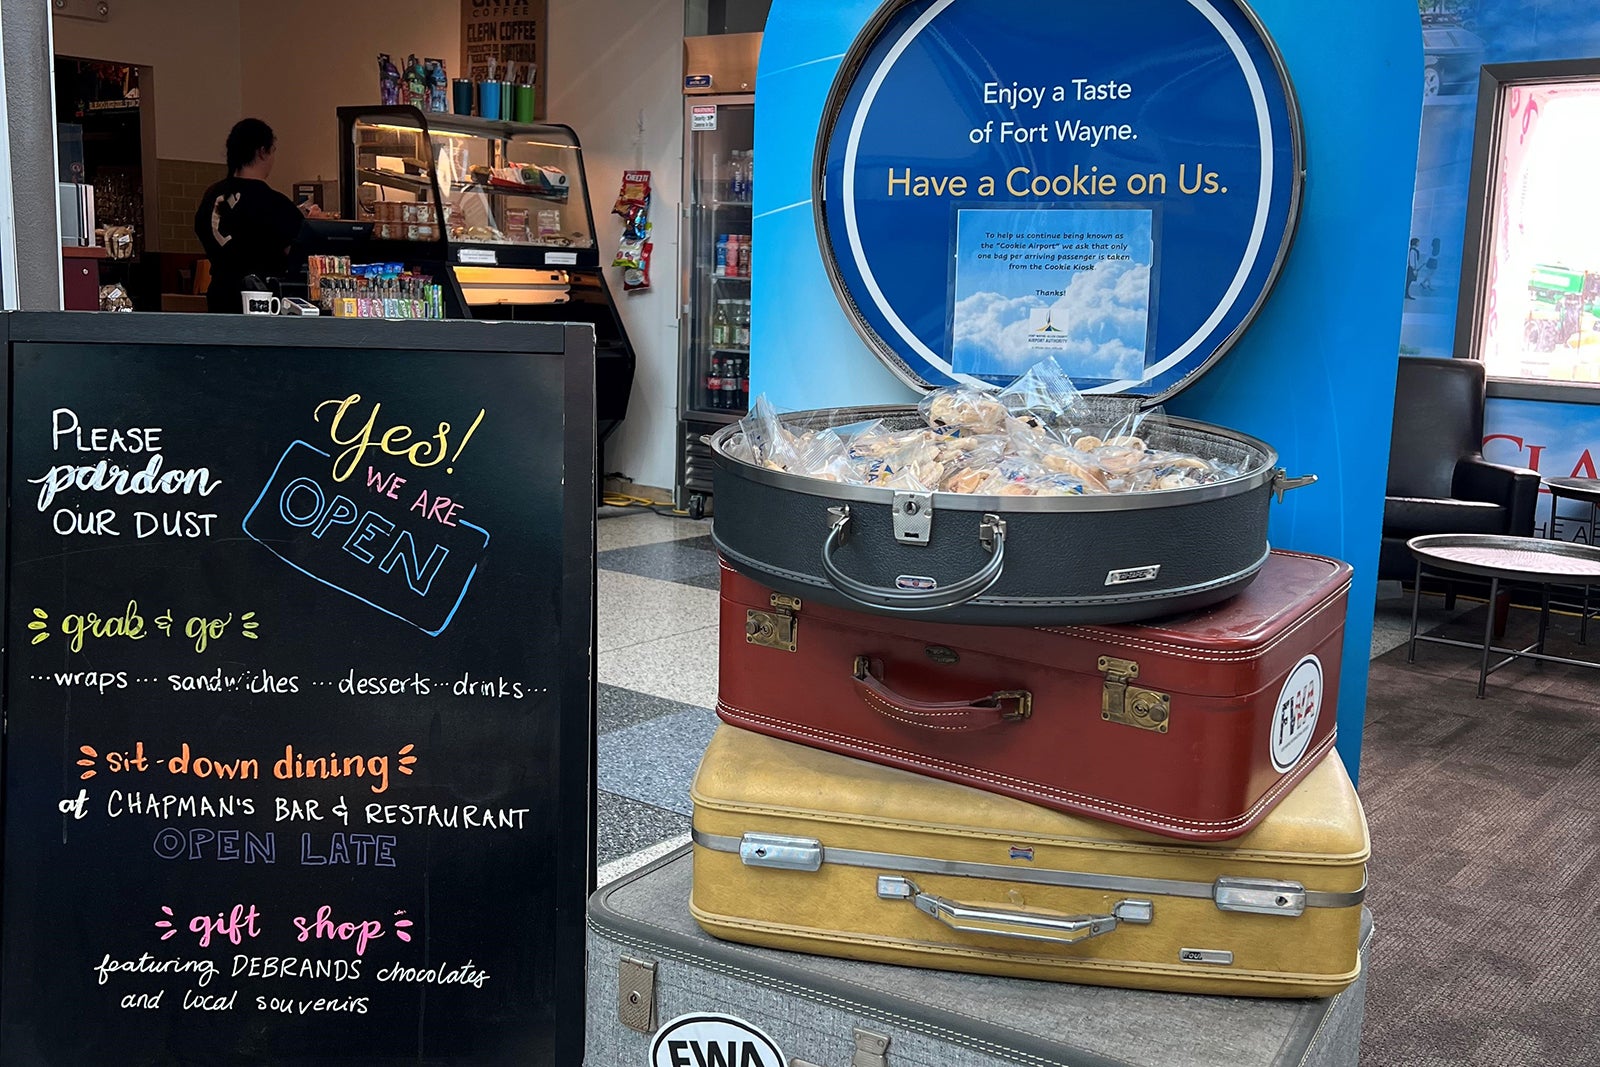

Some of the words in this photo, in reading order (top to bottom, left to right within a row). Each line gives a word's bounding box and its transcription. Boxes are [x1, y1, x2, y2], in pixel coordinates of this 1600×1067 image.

[473, 7, 528, 17] COFFEE
[467, 22, 496, 42] CLEAN
[501, 21, 536, 40] COFFEE
[983, 82, 1046, 110] Enjoy
[1052, 87, 1065, 102] a
[1072, 79, 1132, 101] Taste
[969, 122, 994, 144] of
[1000, 122, 1048, 143] Fort
[1055, 120, 1138, 147] Wayne.
[887, 168, 967, 197] Have
[978, 175, 995, 196] a
[1006, 165, 1117, 196] Cookie
[1126, 174, 1166, 195] on
[1178, 164, 1228, 195] Us.
[997, 232, 1013, 241] help
[1063, 232, 1084, 241] being
[1028, 242, 1060, 251] Airport"
[1111, 243, 1128, 251] only
[994, 253, 1008, 261] bag
[1024, 253, 1055, 261] arriving
[1057, 254, 1096, 262] passenger
[1073, 263, 1097, 271] Kiosk.
[52, 408, 163, 453] PLEASE
[314, 394, 485, 481] Yes!
[27, 454, 222, 511] pardon
[366, 465, 405, 500] WE
[411, 489, 464, 527] ARE
[53, 509, 120, 536] OUR
[134, 511, 217, 538] DUST
[279, 477, 449, 596] OPEN
[62, 600, 147, 653] grab
[154, 614, 174, 637] &
[186, 612, 232, 653] go
[54, 672, 127, 694] wraps
[168, 668, 299, 693] sandwiches
[339, 669, 431, 695] desserts
[453, 672, 524, 698] drinks
[106, 742, 258, 779] sit-down
[274, 744, 389, 793] dining
[59, 789, 89, 819] at
[108, 790, 254, 819] CHAPMAN'S
[275, 797, 324, 821] BAR
[331, 797, 348, 825] &
[365, 803, 529, 830] RESTAURANT
[154, 828, 275, 864] OPEN
[301, 833, 397, 867] LATE
[189, 904, 260, 947] gift
[294, 905, 385, 955] shop
[94, 953, 219, 986] featuring
[232, 958, 362, 981] DEBRANDS
[377, 960, 490, 987] chocolates
[121, 990, 164, 1009] and
[183, 990, 236, 1011] local
[256, 995, 369, 1014] souvenirs
[668, 1040, 766, 1067] FWA
